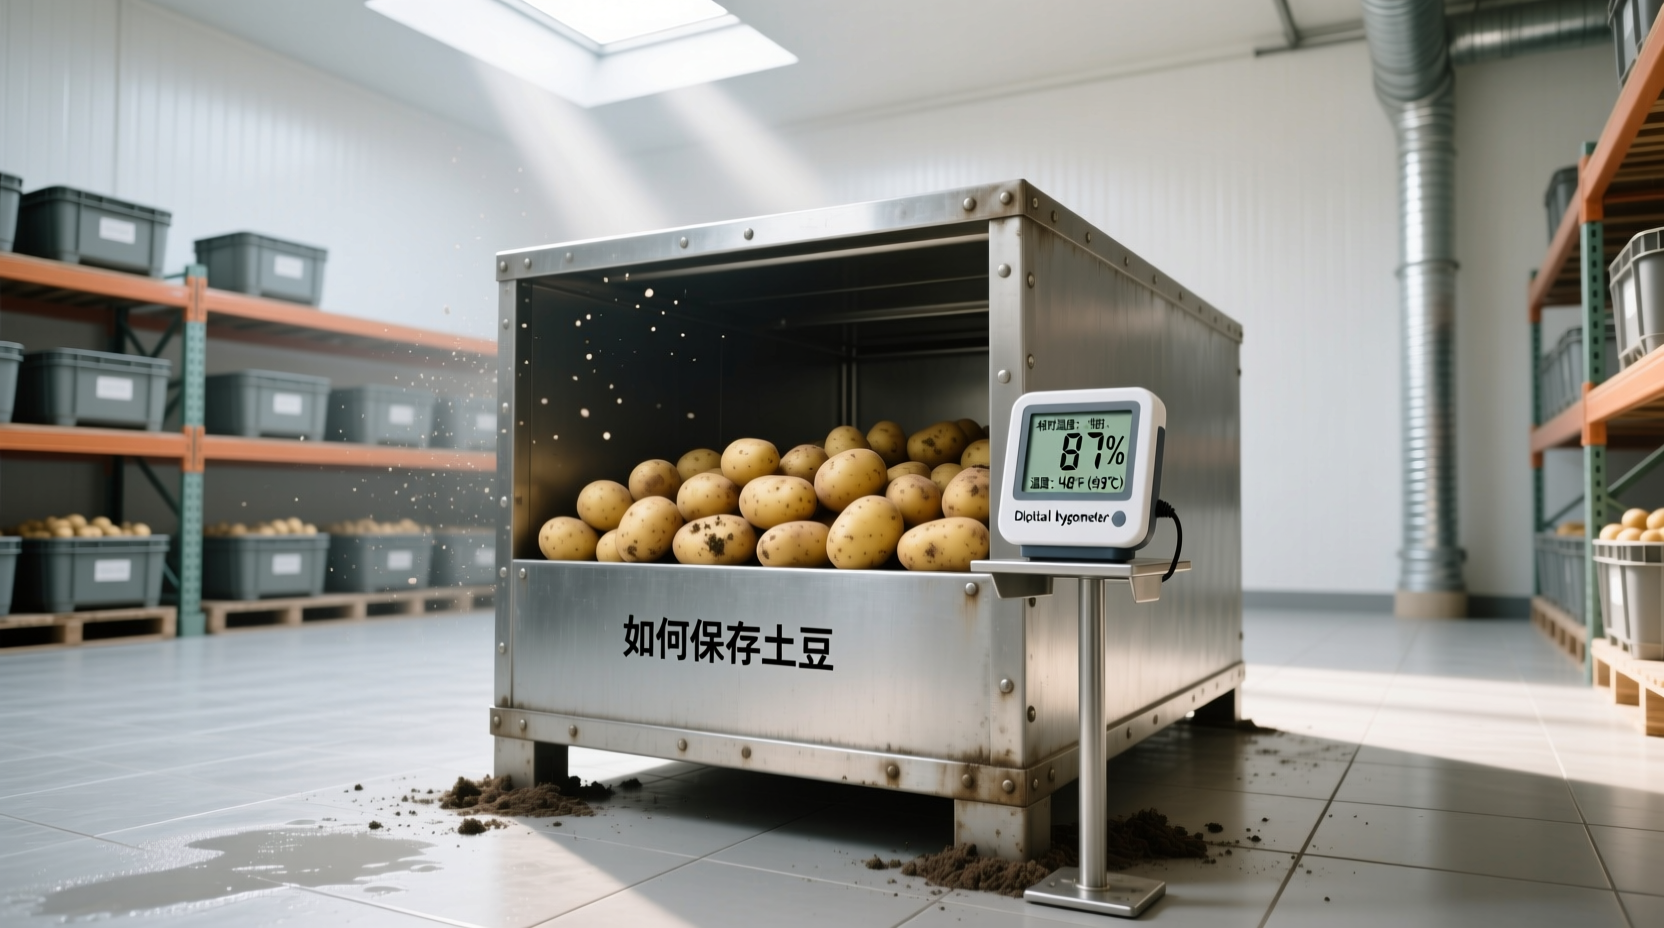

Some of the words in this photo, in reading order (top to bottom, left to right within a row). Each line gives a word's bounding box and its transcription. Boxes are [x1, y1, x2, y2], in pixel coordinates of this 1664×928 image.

[1060, 432, 1125, 471] 87%
[623, 614, 834, 671] 如何保存土豆
